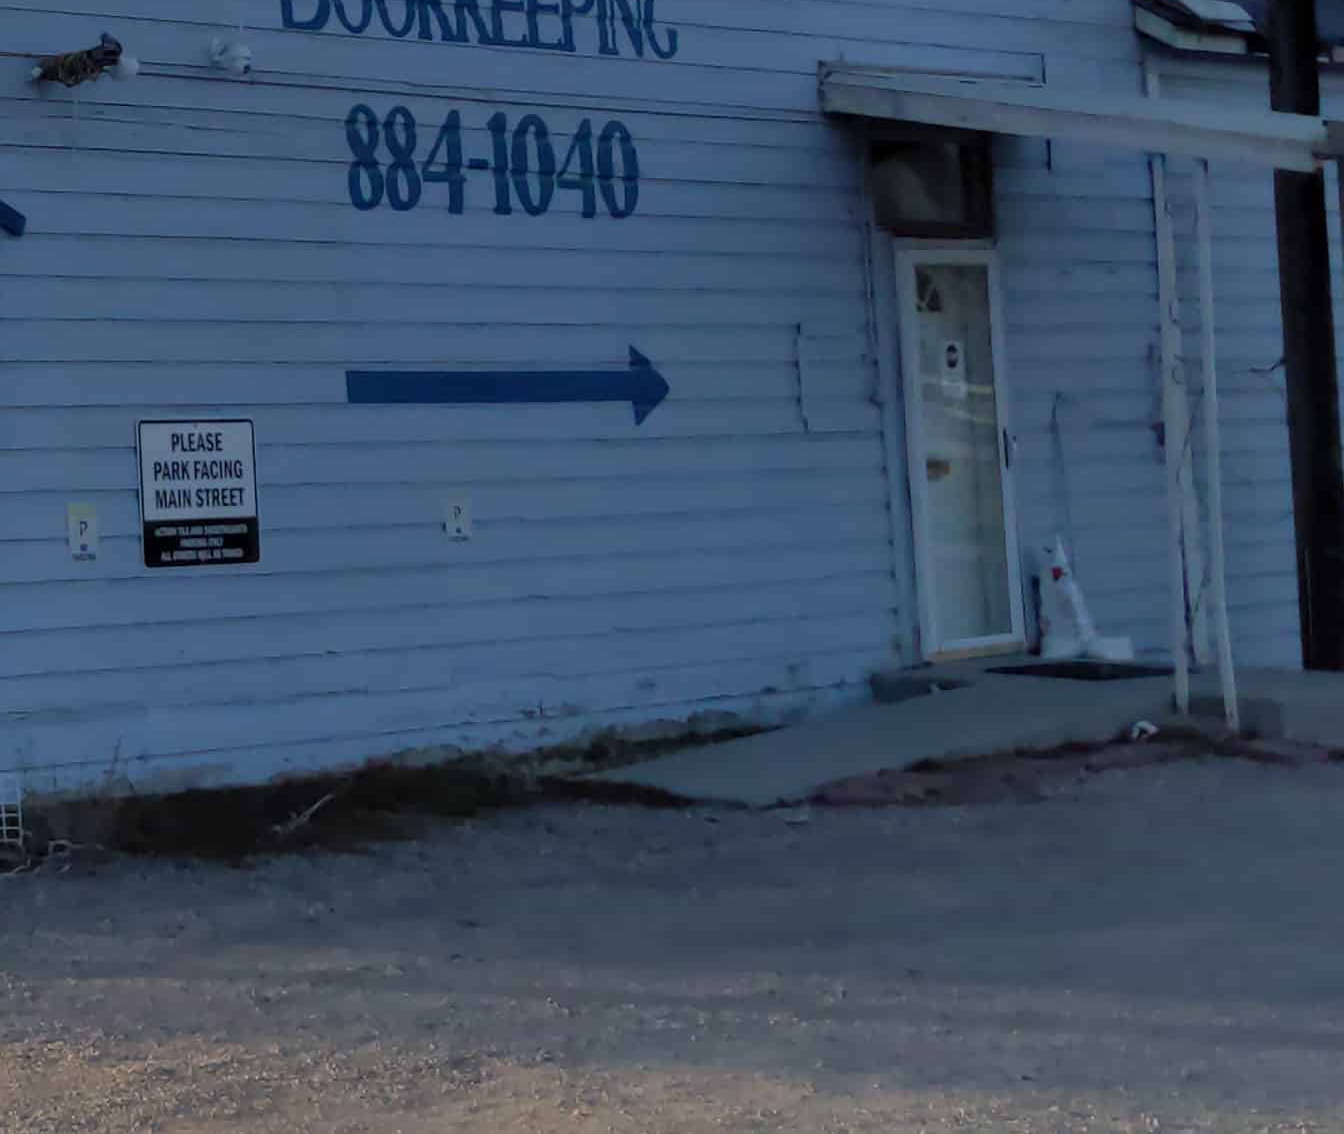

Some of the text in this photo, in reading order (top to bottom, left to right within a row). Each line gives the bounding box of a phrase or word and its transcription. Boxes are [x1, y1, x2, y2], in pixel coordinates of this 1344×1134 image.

[345, 103, 641, 220] 884-1040
[171, 432, 223, 453] PLEASE
[153, 459, 243, 482] PARK FACING
[155, 487, 245, 510] MAIN STREET
